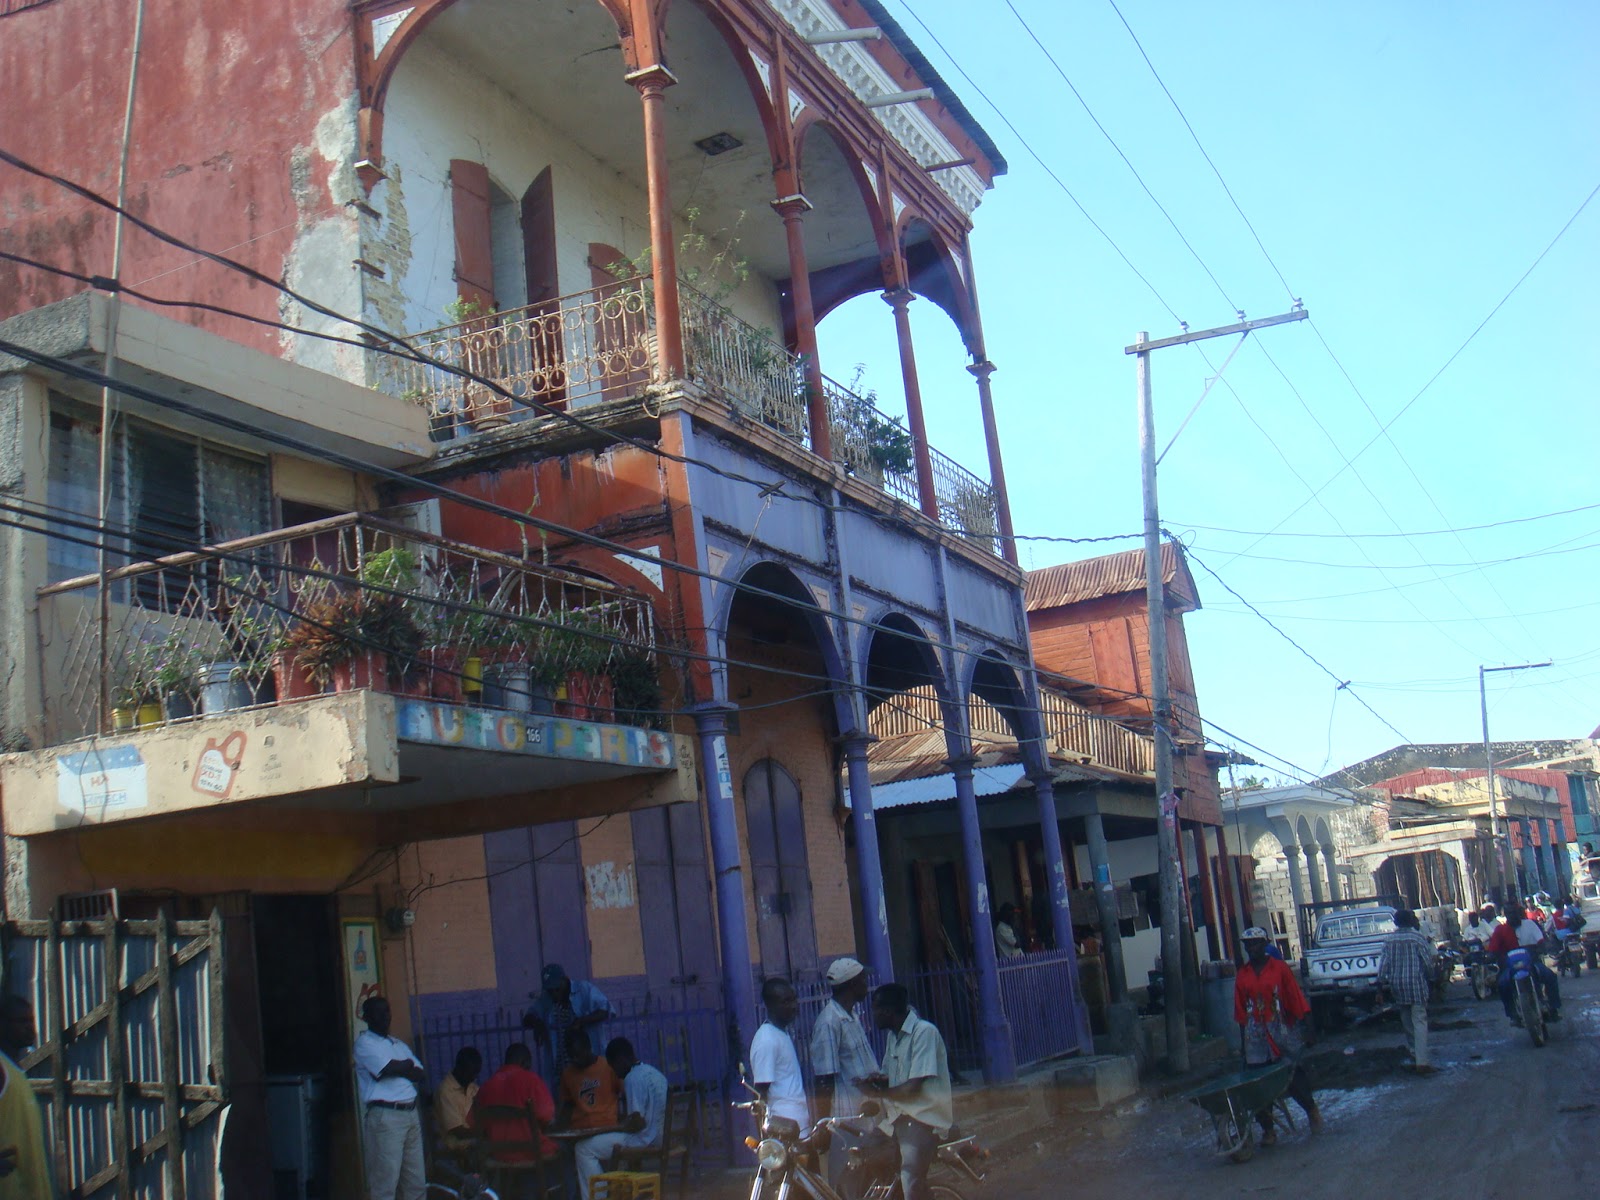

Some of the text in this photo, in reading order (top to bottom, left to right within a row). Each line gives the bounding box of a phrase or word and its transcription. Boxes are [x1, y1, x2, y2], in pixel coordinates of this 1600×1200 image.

[399, 703, 526, 750] AUTO
[547, 719, 672, 767] PARTS
[1319, 956, 1380, 973] TOYOT
